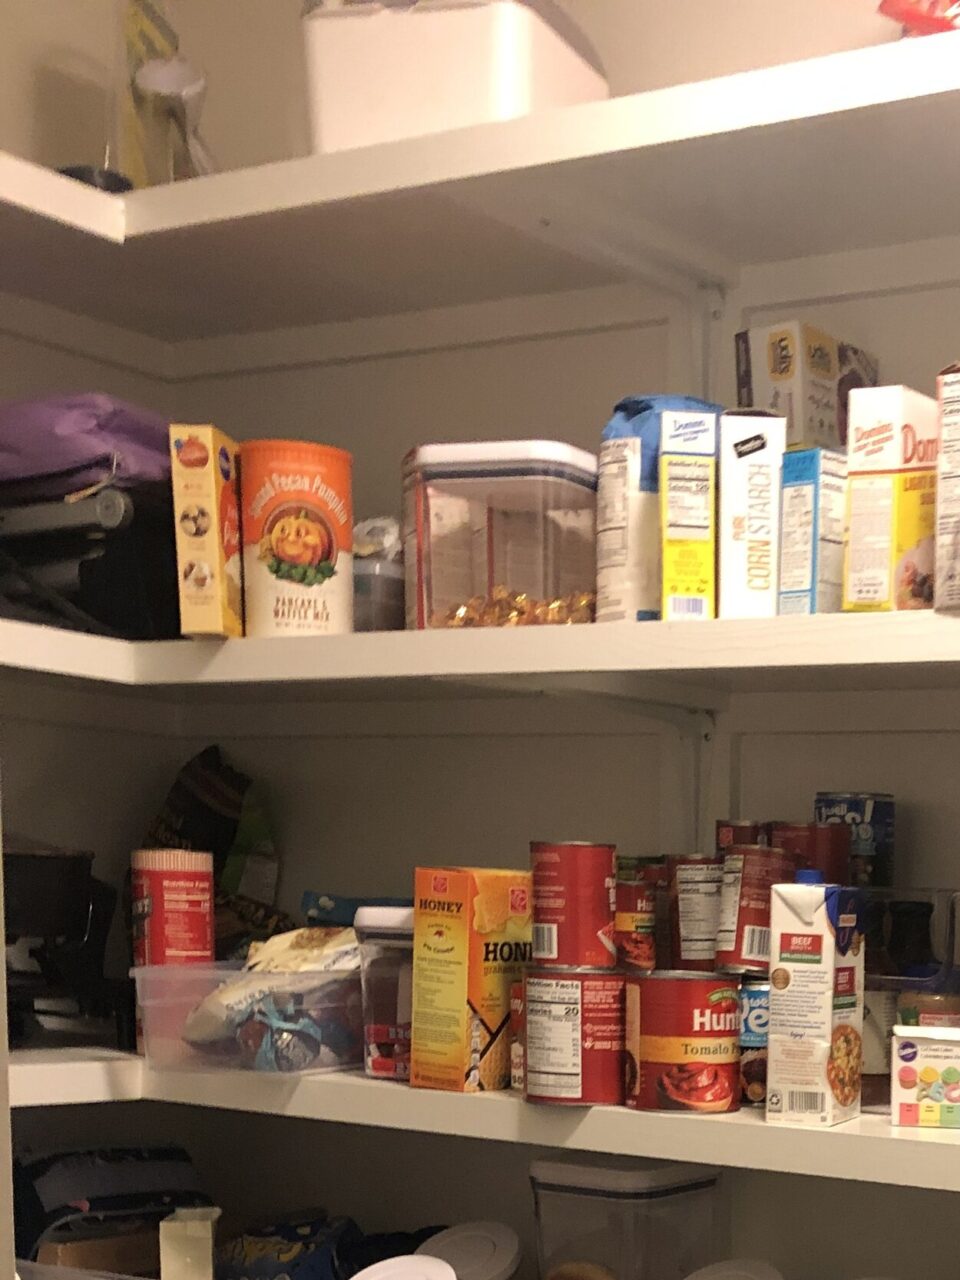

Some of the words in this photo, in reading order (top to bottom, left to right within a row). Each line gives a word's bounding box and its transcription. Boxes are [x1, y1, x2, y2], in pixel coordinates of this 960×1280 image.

[902, 423, 938, 464] Dom
[748, 463, 771, 535] STARCH
[747, 540, 771, 591] CORN
[419, 898, 464, 913] HONEY
[790, 935, 813, 946] BEEF
[483, 941, 532, 963] HON
[555, 981, 580, 990] Facts
[564, 1007, 580, 1016] 20
[682, 1043, 729, 1056] Tomato
